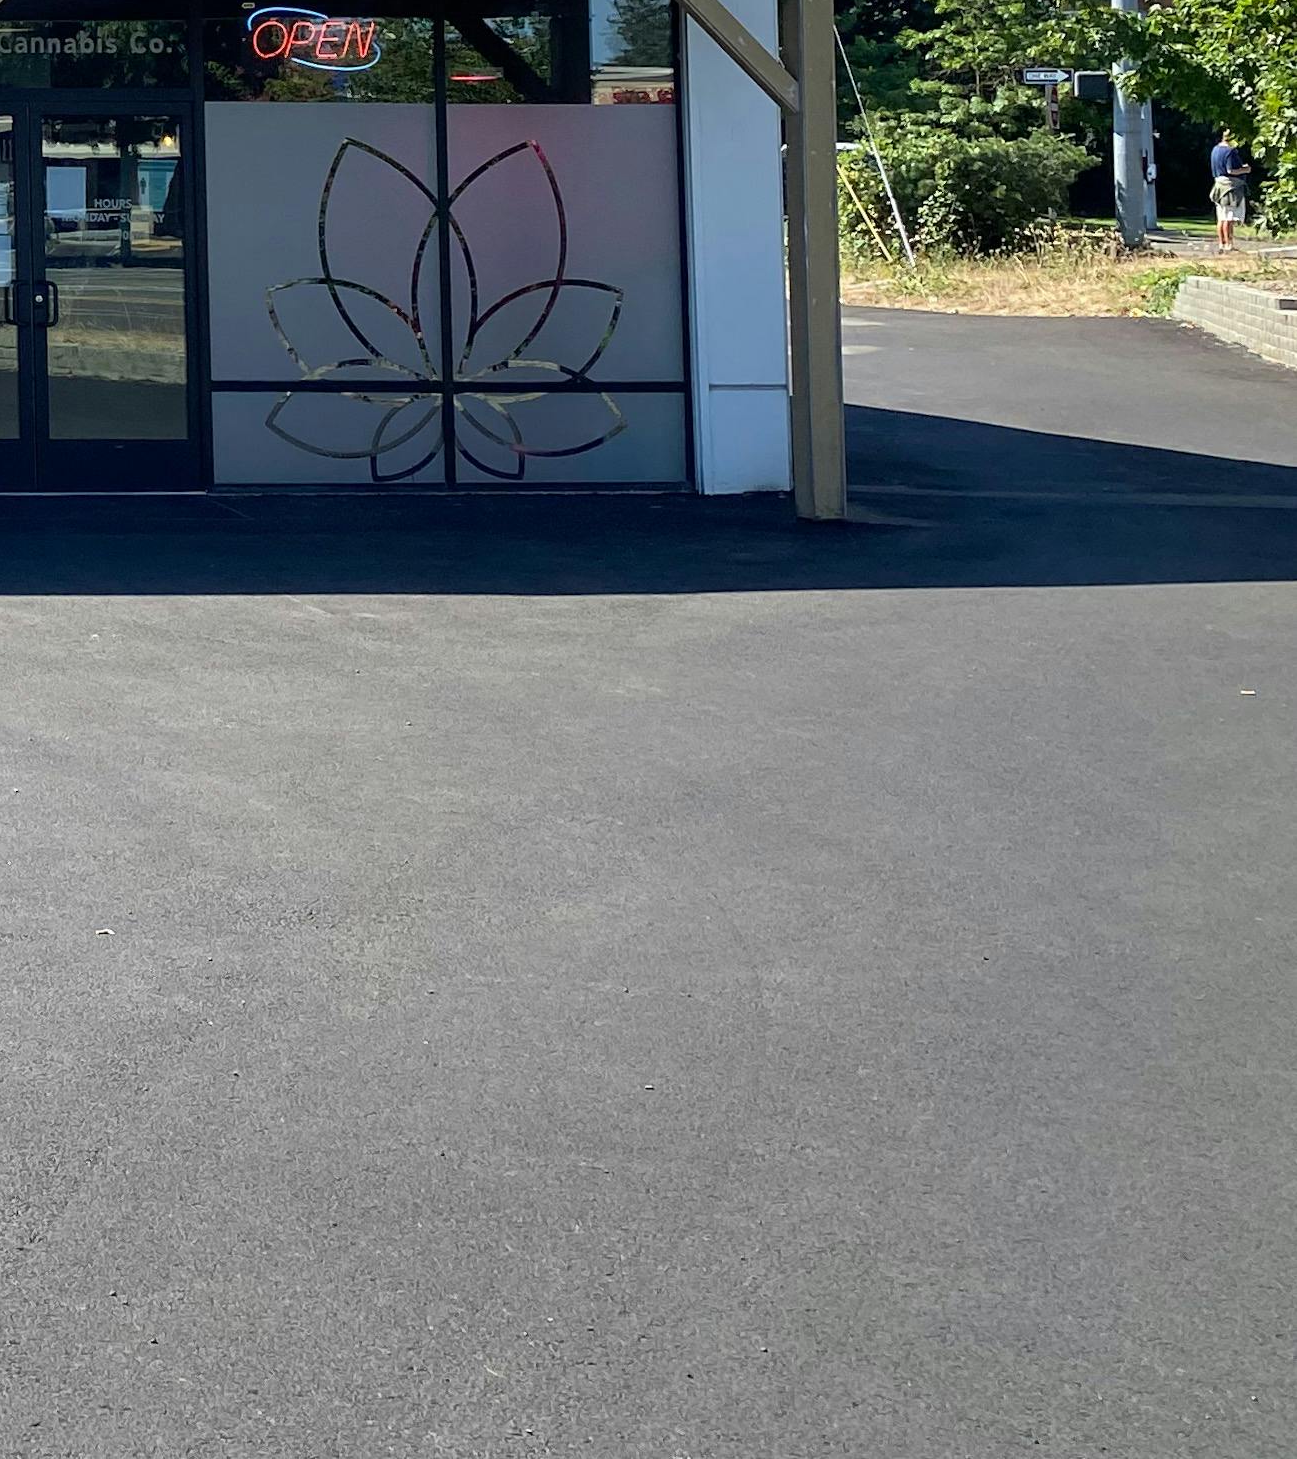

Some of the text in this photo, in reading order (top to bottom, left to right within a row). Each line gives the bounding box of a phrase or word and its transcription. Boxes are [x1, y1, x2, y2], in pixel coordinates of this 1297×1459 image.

[130, 32, 173, 54] Co.
[253, 20, 375, 59] OPEN
[94, 198, 132, 209] HOURS
[120, 213, 165, 223] SUAY
